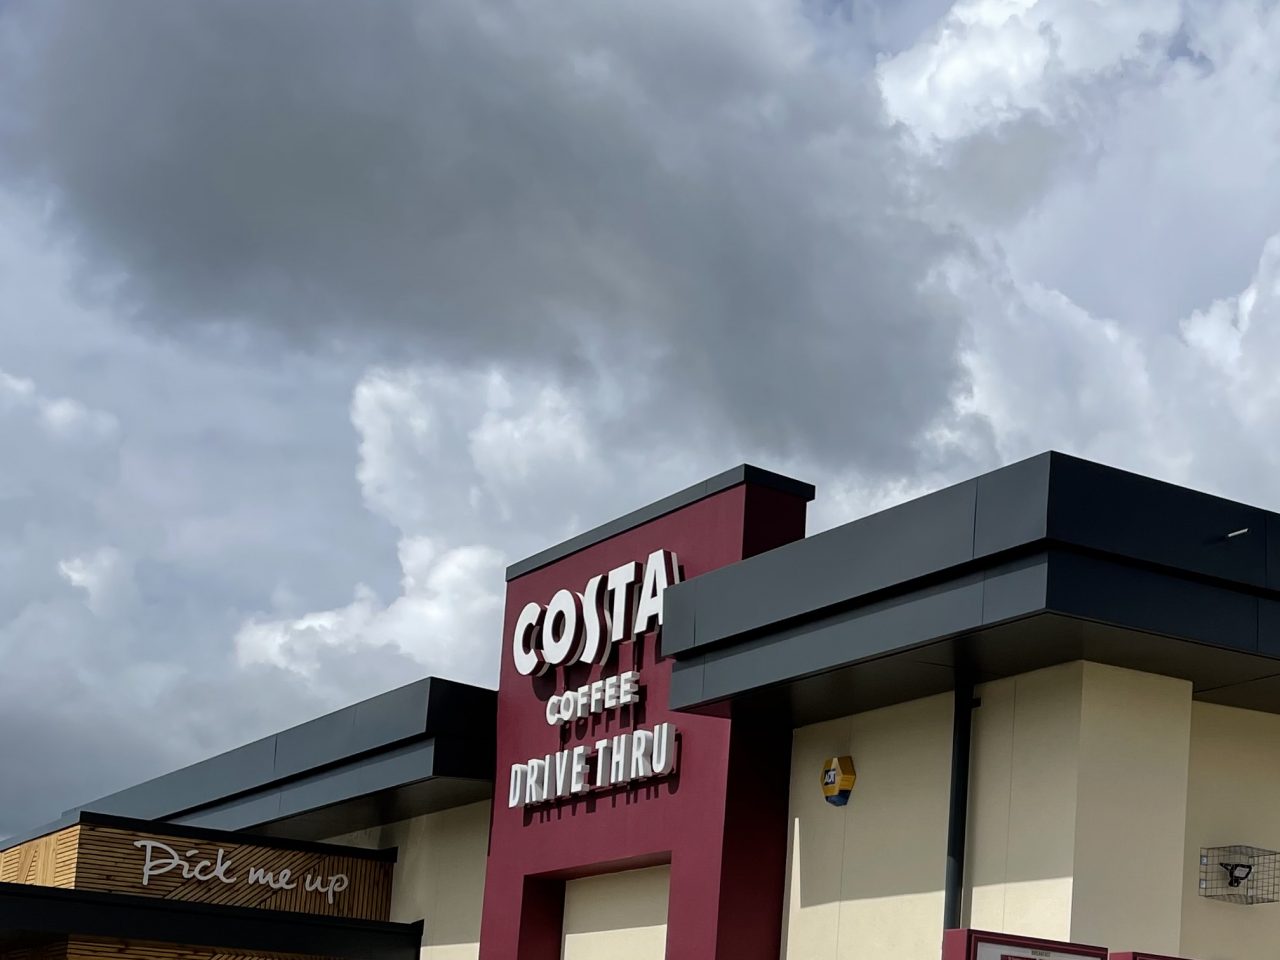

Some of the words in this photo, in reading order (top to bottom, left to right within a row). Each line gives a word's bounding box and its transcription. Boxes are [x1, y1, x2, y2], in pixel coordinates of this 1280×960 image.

[513, 549, 674, 676] COSTA
[546, 671, 640, 725] COFFEE
[508, 745, 590, 808] DRIVE
[596, 722, 676, 787] THRU
[133, 840, 237, 886] Pick
[248, 867, 297, 889] me
[305, 873, 349, 904] up
